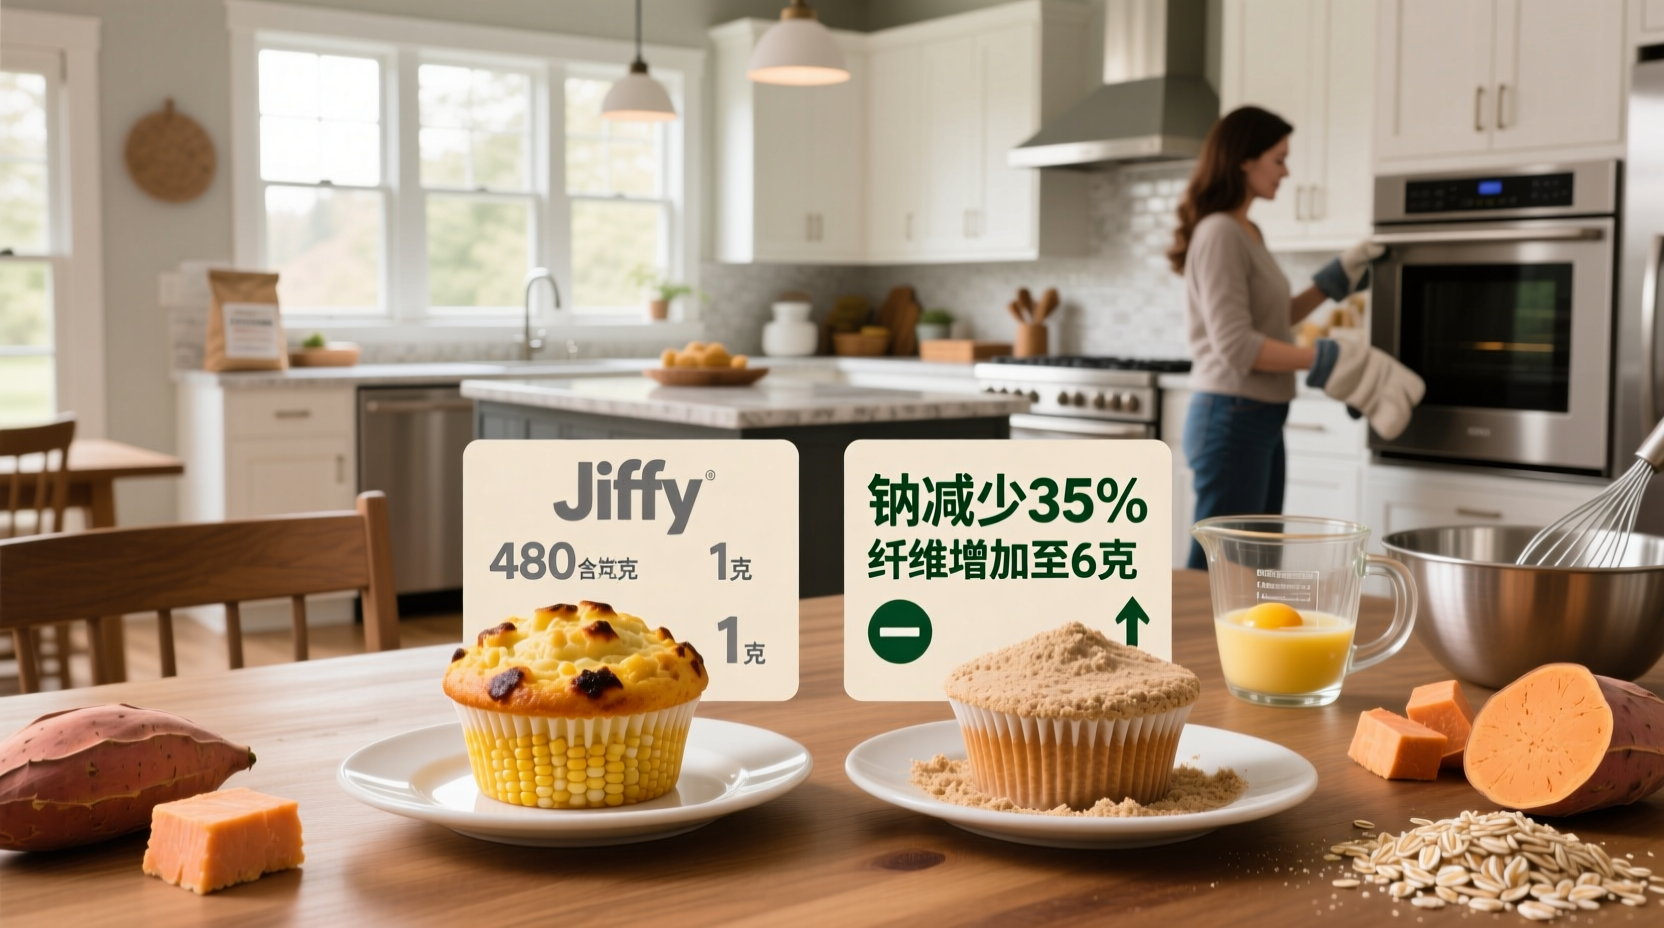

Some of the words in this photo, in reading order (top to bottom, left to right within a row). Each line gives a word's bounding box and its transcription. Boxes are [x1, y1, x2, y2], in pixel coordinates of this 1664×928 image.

[867, 472, 1148, 528] 钠减少35%
[709, 542, 753, 582] 1克
[867, 538, 1138, 581] 纤维增加至6克
[717, 616, 766, 665] 1克
